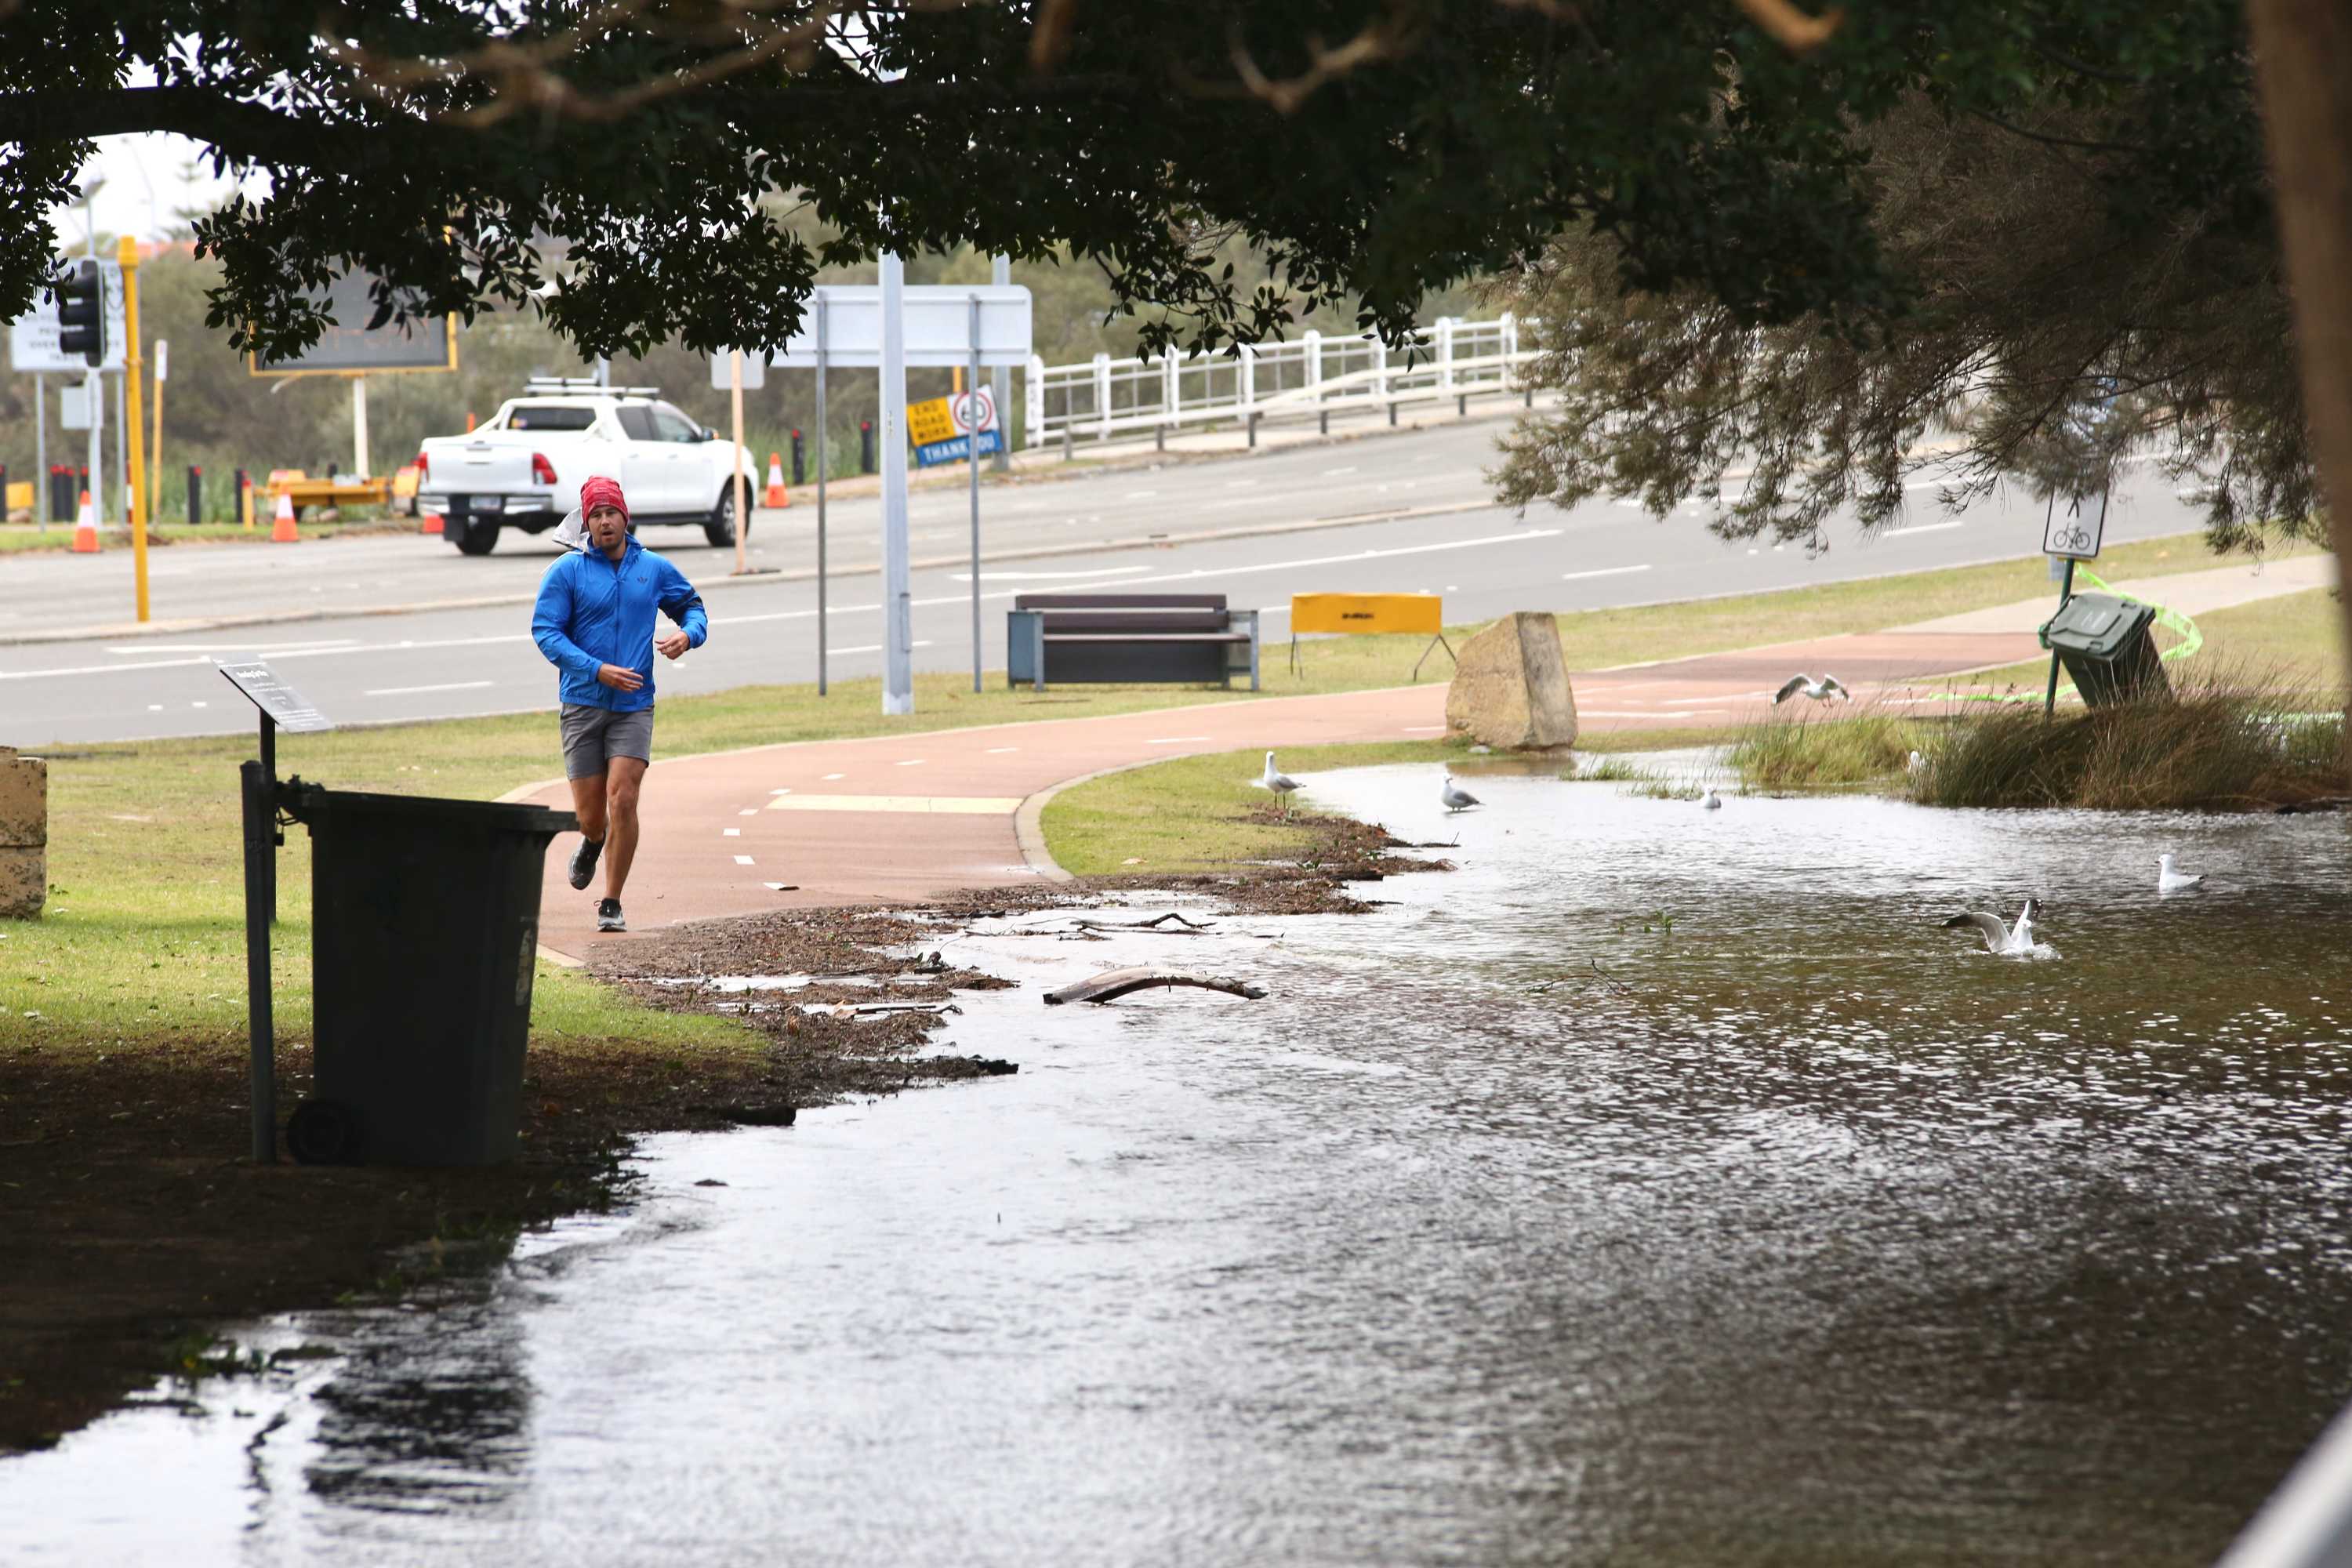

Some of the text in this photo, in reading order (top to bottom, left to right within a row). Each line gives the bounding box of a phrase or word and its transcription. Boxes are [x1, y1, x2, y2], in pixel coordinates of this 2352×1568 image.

[914, 401, 938, 415] END
[915, 414, 946, 427] ROAD
[917, 427, 949, 440] WORK
[924, 434, 996, 462] THANK OU
